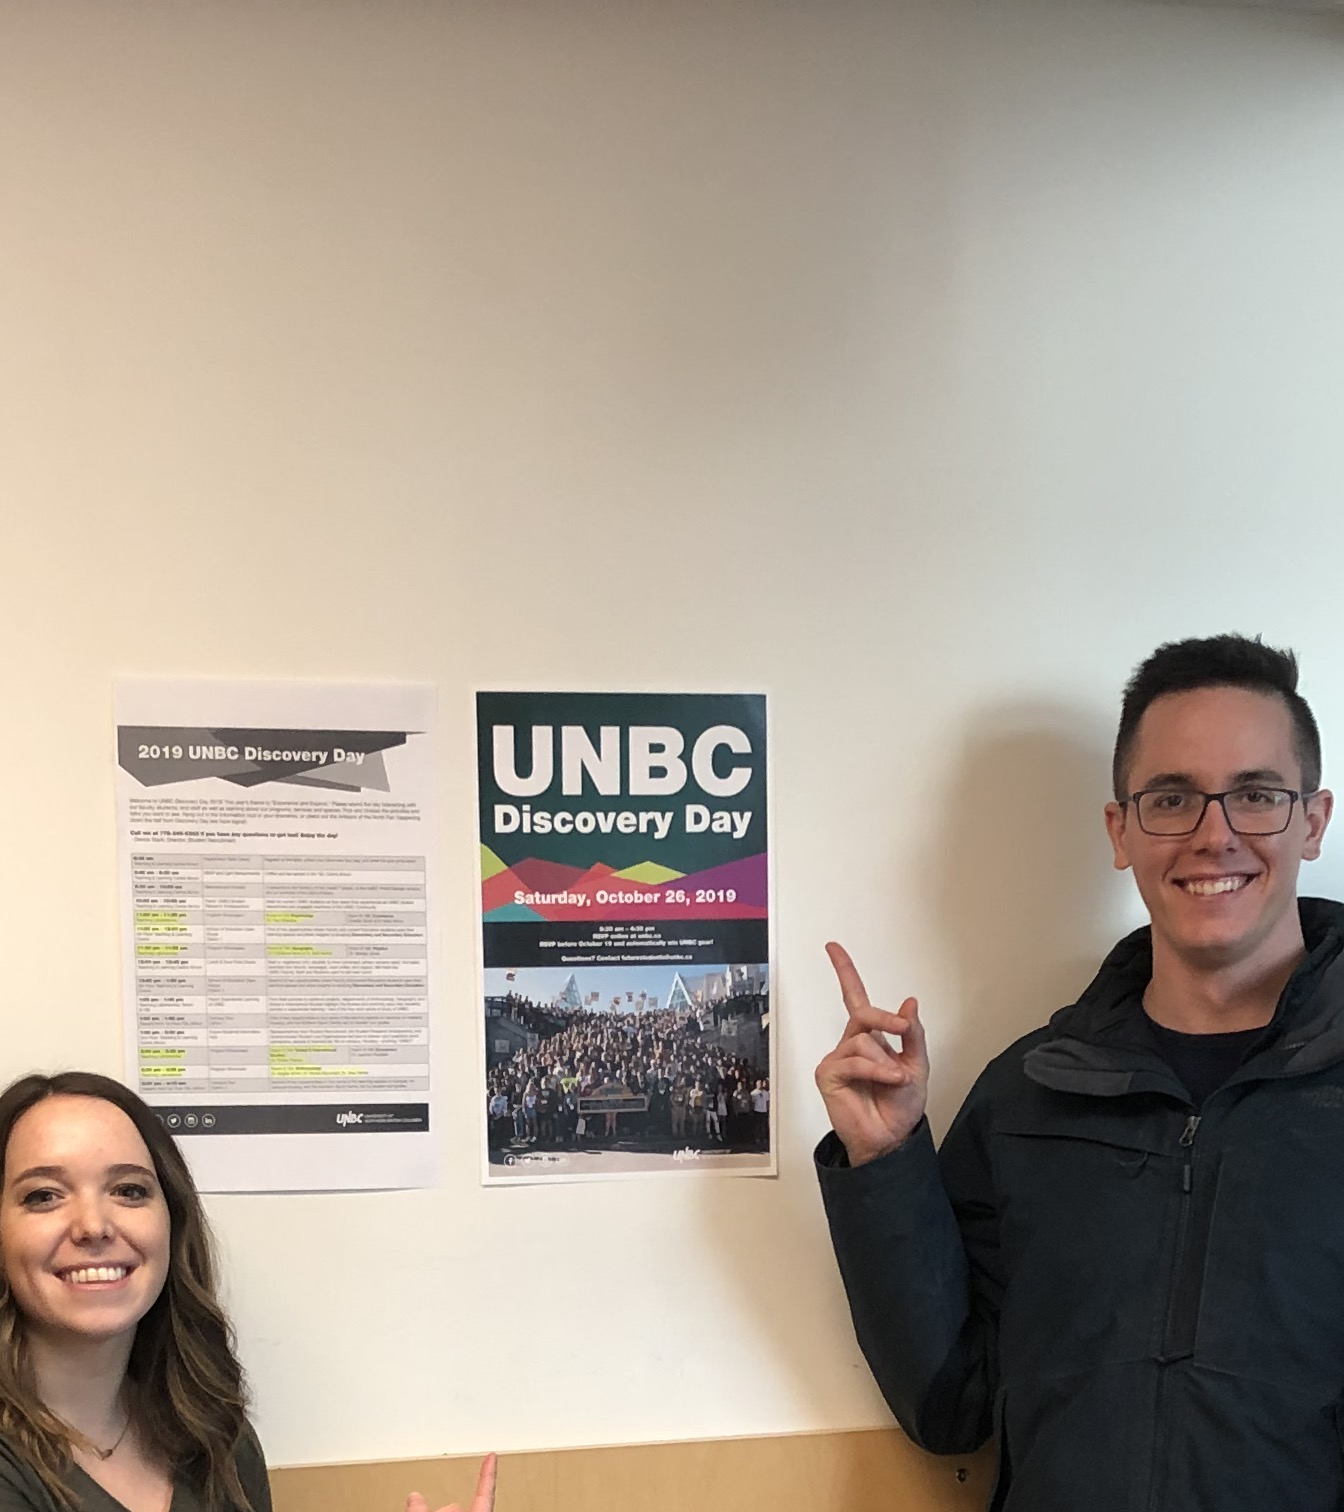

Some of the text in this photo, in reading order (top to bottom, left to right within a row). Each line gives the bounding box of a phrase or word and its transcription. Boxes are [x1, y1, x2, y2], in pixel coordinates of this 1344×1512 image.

[138, 744, 366, 766] 2019 UNBC Discovery Day
[492, 724, 753, 798] UNBC
[493, 803, 753, 840] Discovery Day
[513, 888, 737, 907] Saturday, October 26, 2019
